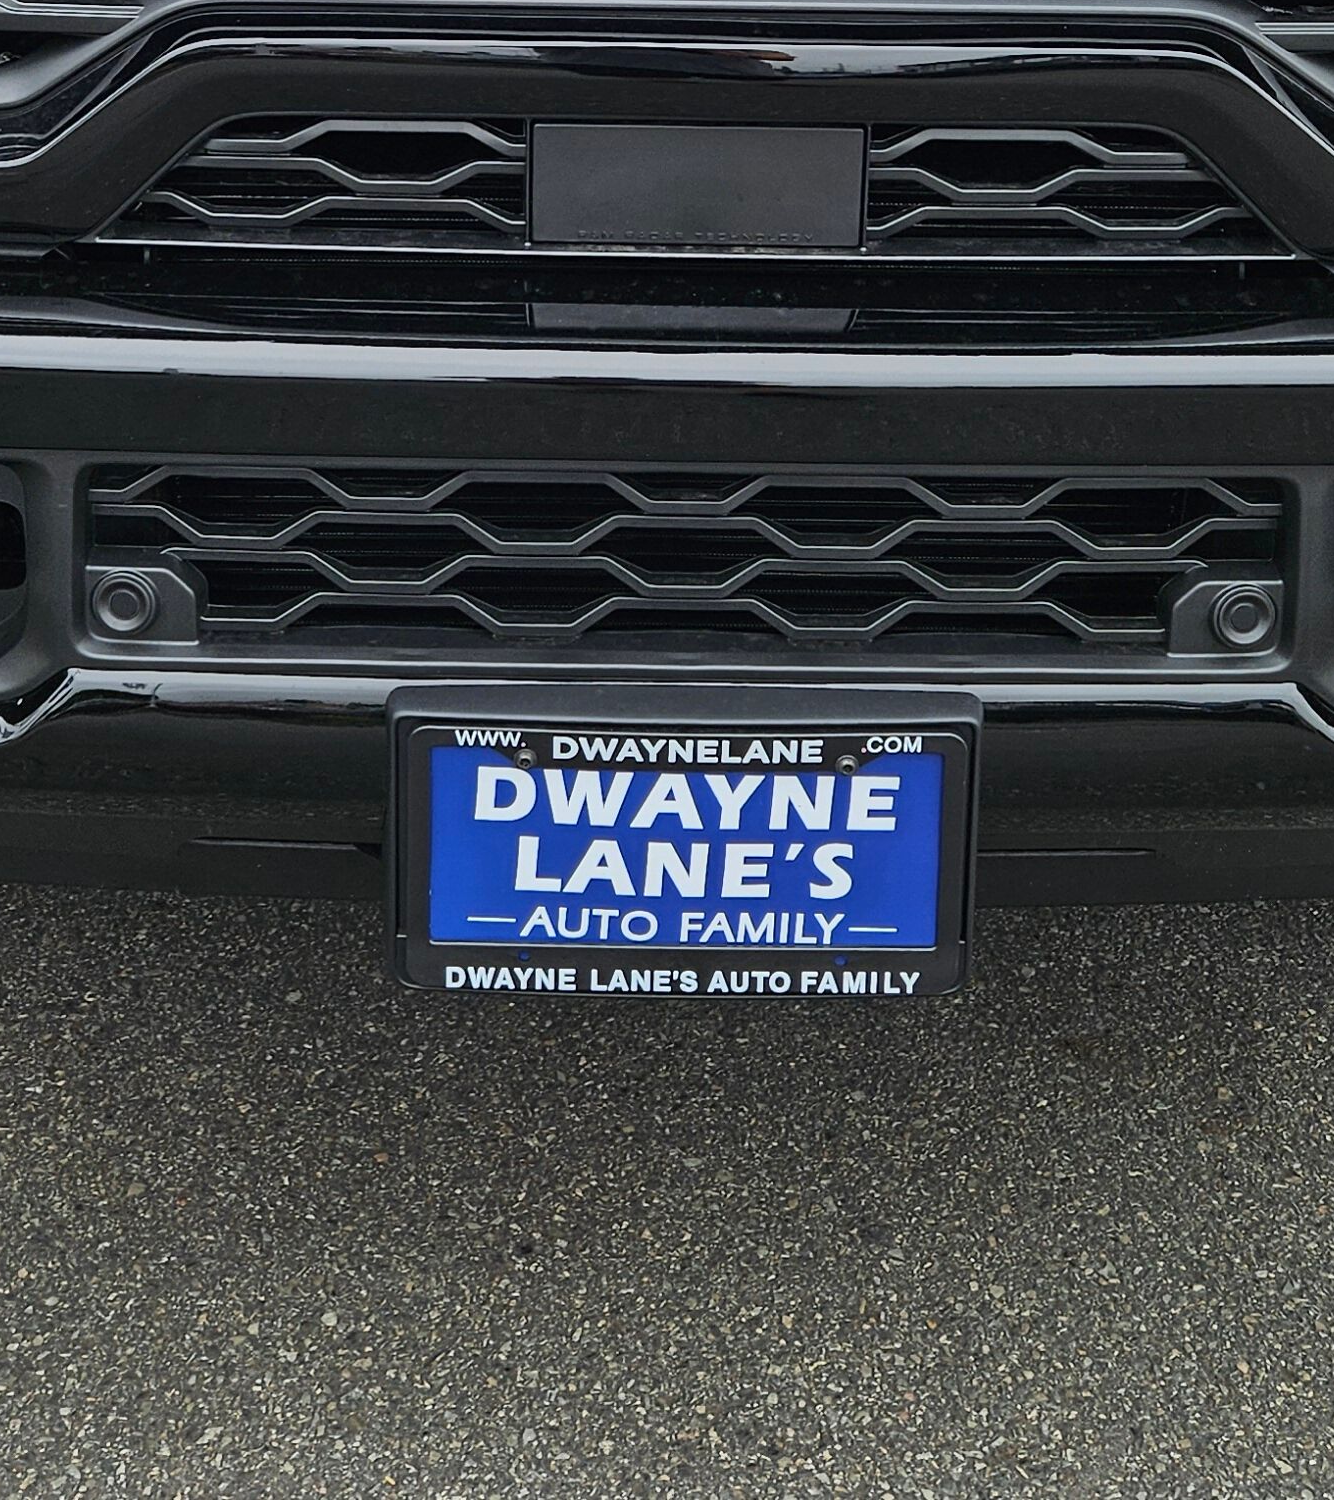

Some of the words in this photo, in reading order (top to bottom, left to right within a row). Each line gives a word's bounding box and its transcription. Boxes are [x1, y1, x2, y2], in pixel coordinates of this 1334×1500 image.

[552, 736, 824, 764] DWAYNELANE
[861, 735, 923, 754] .COM
[473, 765, 901, 832] DWAYNE
[514, 835, 855, 899] LANE'S
[519, 905, 659, 942] AUTO
[679, 911, 846, 945] FAMILY
[444, 966, 577, 991] DWAYNE
[590, 968, 699, 992] LANE'S
[707, 971, 791, 993] AUTO
[799, 971, 921, 995] FAMILY
